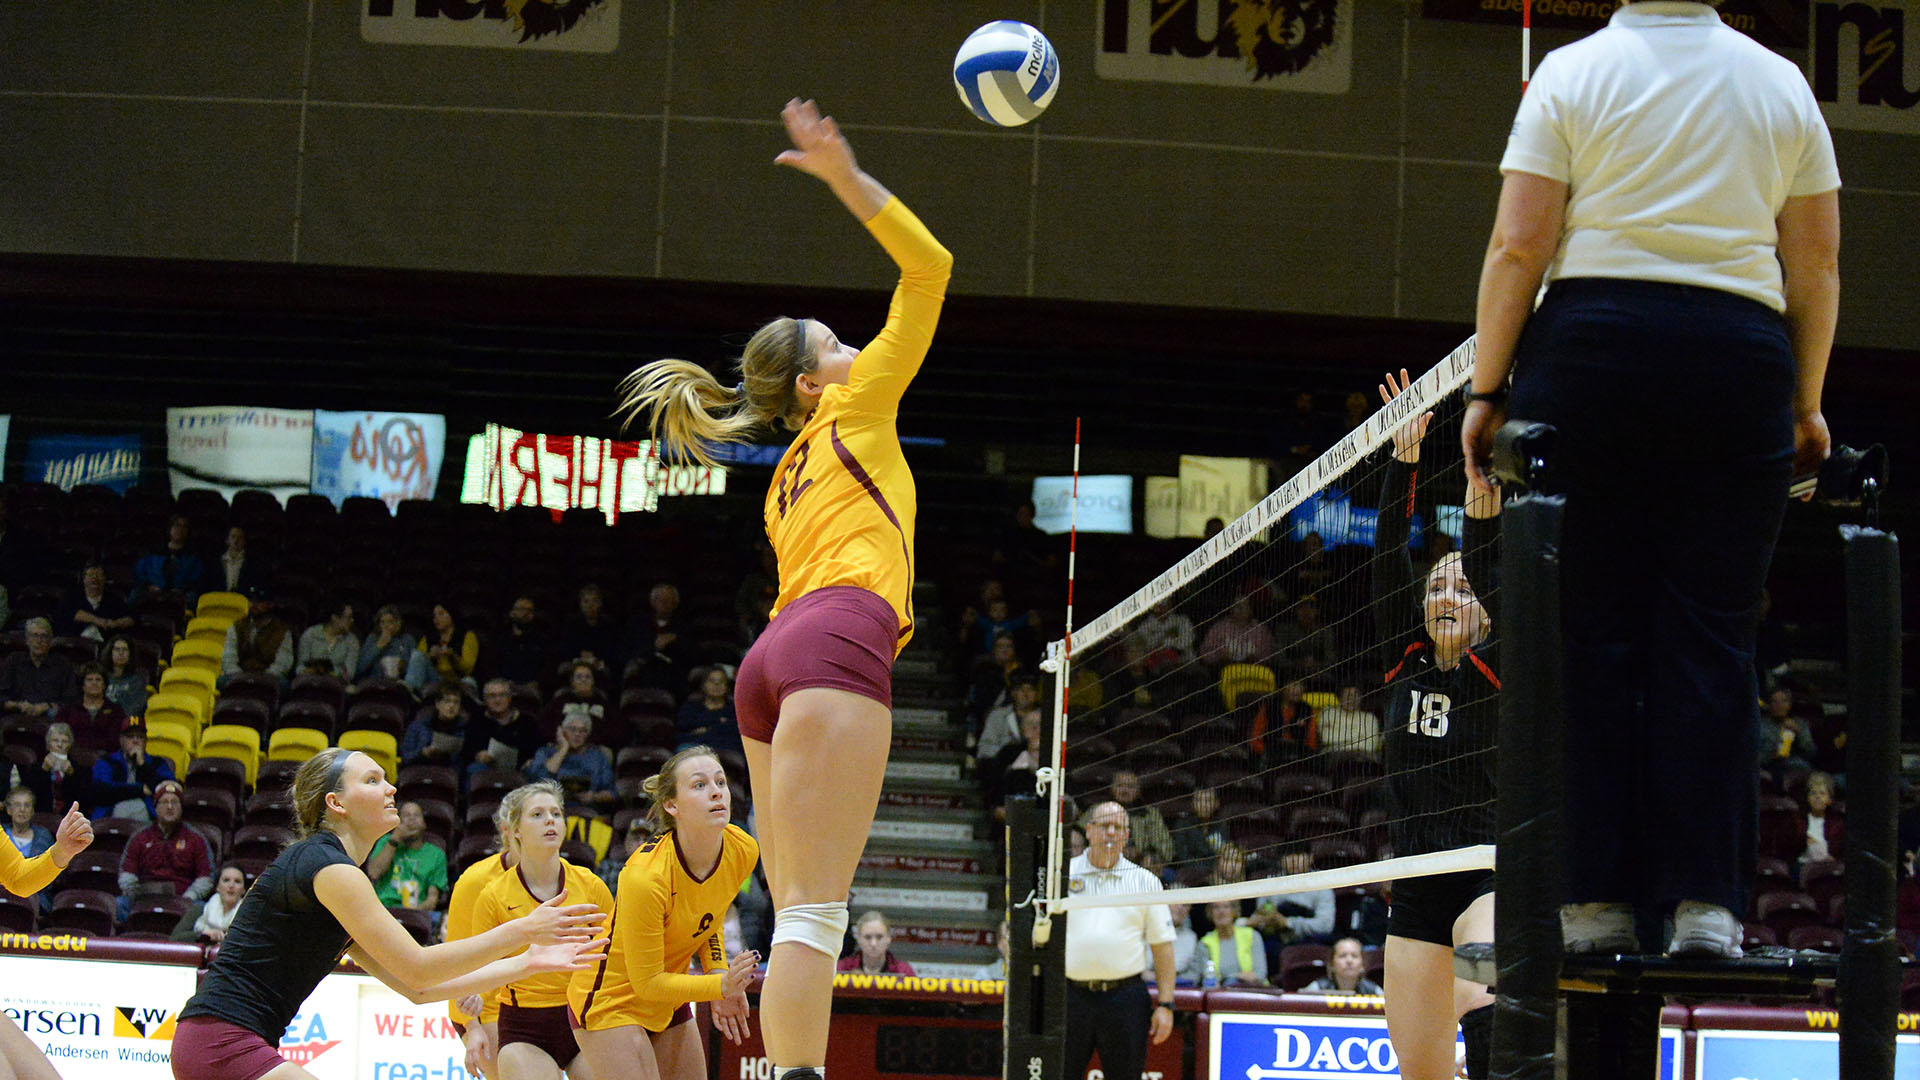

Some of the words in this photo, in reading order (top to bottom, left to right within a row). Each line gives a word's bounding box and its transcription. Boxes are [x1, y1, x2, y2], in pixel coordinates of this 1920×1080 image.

[1408, 690, 1451, 737] 18
[0, 932, 87, 951] rn.edu
[374, 1013, 414, 1037] WE
[45, 1043, 109, 1060] Andersen
[118, 1048, 171, 1063] Window
[1272, 1028, 1398, 1072] DACO
